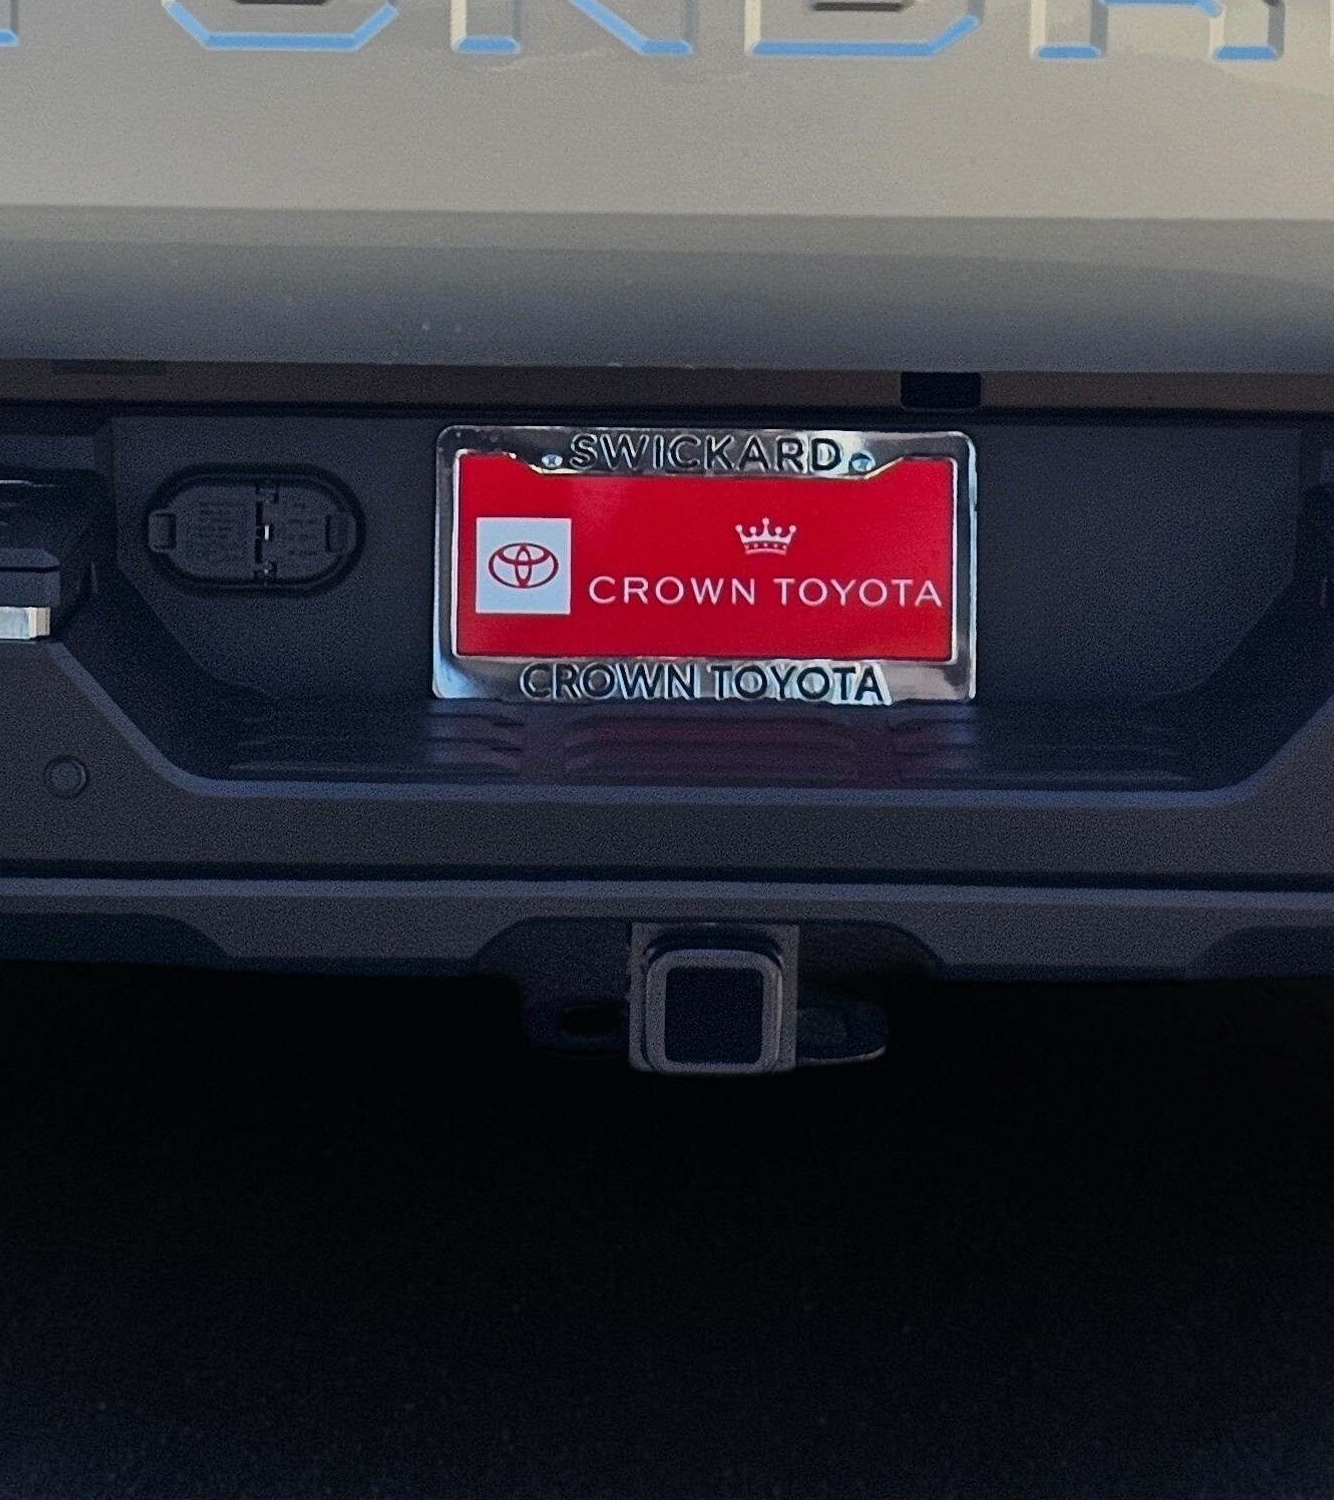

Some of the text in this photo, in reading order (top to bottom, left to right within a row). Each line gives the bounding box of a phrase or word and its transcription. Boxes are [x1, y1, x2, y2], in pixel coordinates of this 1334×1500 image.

[569, 434, 845, 472] SWICKARD
[588, 575, 942, 607] CROWN TOYOTA
[520, 662, 891, 705] CROWN TOYOTA
